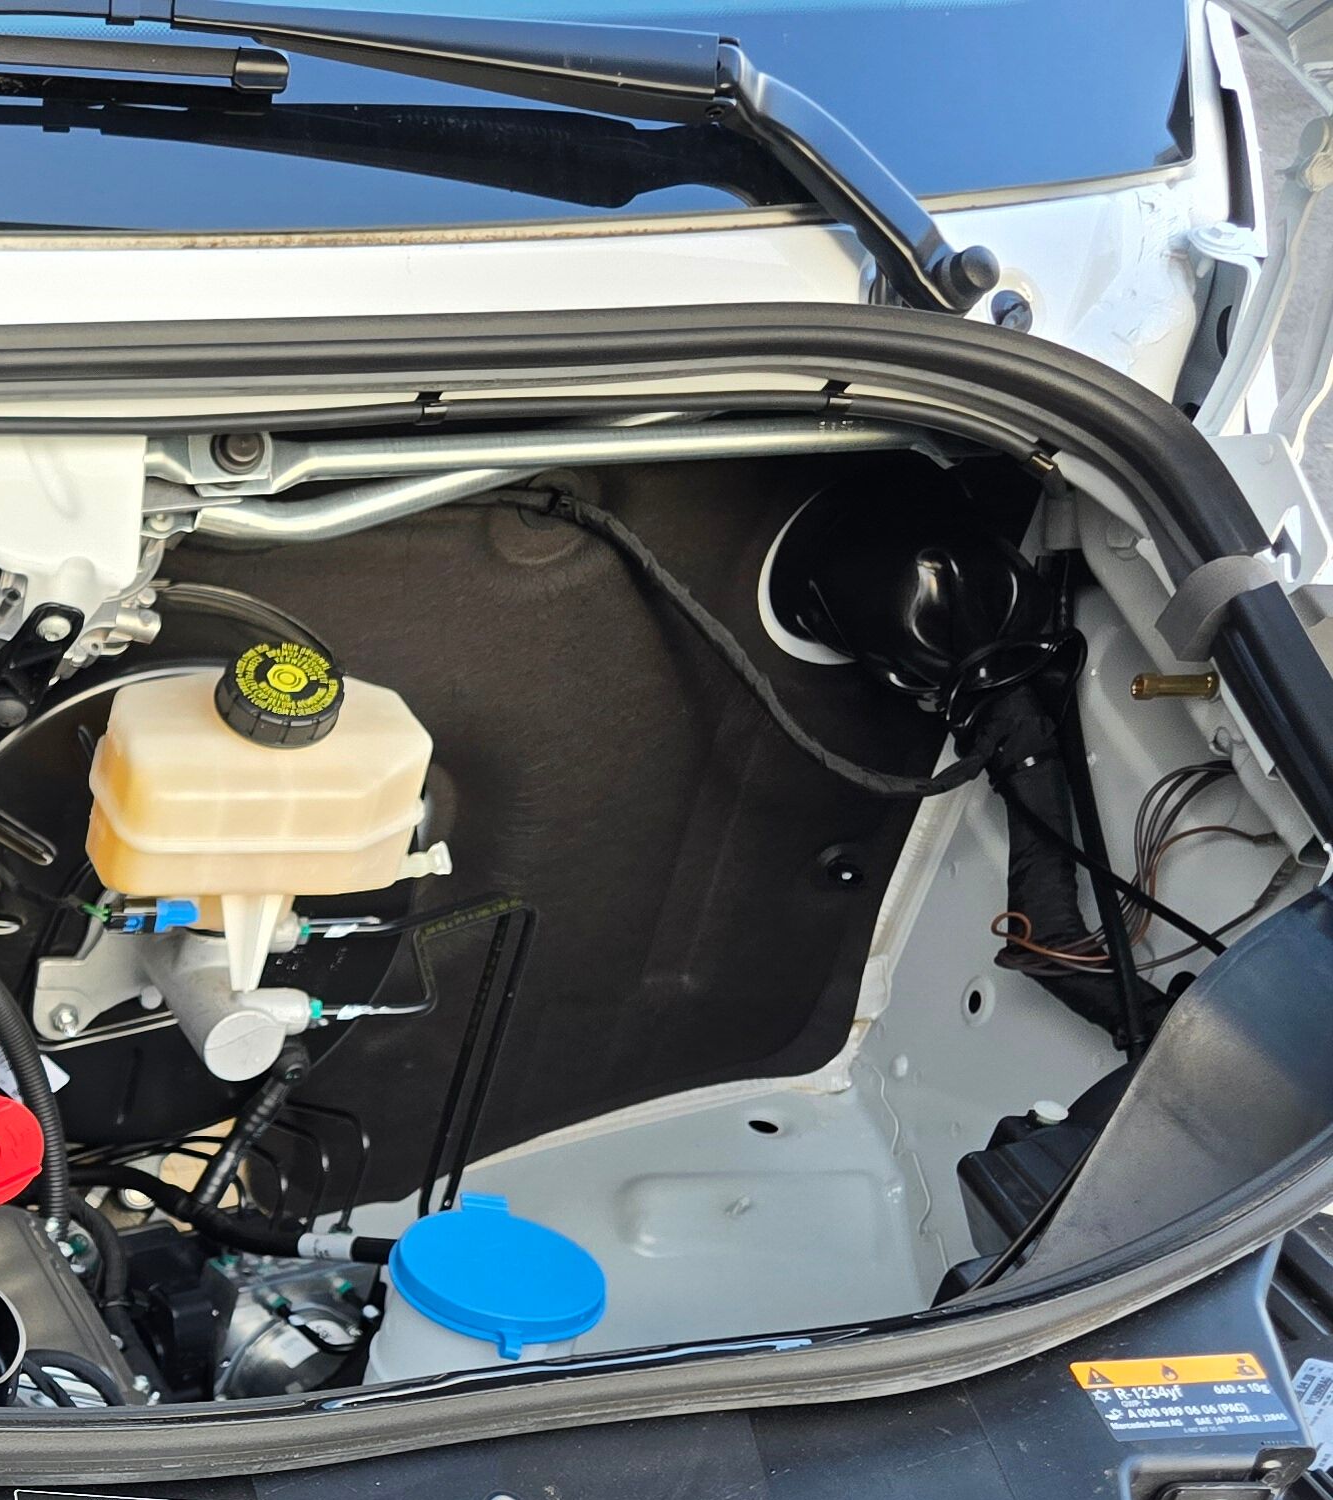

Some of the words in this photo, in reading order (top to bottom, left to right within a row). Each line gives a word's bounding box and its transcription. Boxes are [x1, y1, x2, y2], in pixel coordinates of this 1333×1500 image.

[1114, 1385, 1184, 1402] R-1234yf
[1213, 1385, 1236, 1394] 660
[1247, 1383, 1271, 1395] 10g
[1127, 1409, 1139, 1419] A
[1139, 1408, 1159, 1418] 000
[1219, 1402, 1250, 1416] (PAG)
